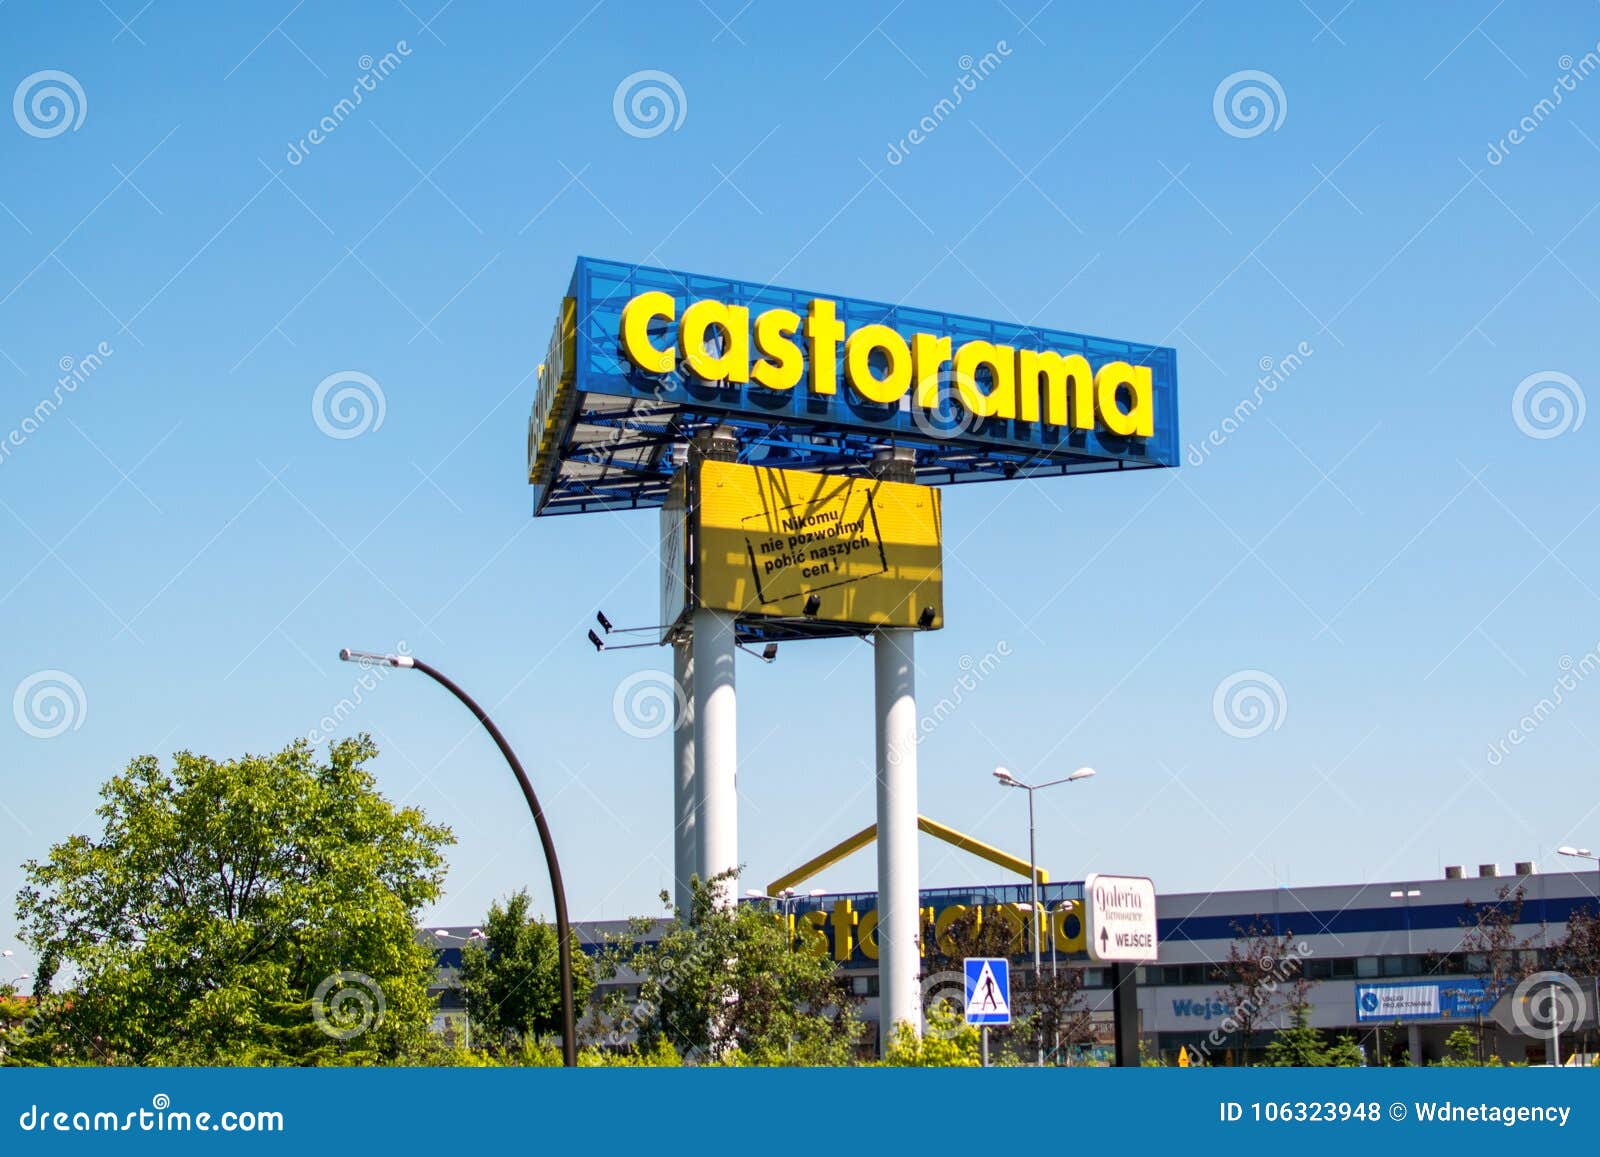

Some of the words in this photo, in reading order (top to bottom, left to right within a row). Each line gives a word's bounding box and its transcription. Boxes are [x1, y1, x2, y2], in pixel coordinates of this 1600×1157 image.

[620, 291, 1154, 437] castorama
[782, 510, 839, 532] Nikomu
[760, 537, 784, 553] nie
[788, 519, 865, 550] pozwolimy
[764, 551, 806, 575] pobić
[810, 535, 870, 561] naszych
[802, 563, 830, 578] cen
[1115, 931, 1152, 947] WEJŚCIE
